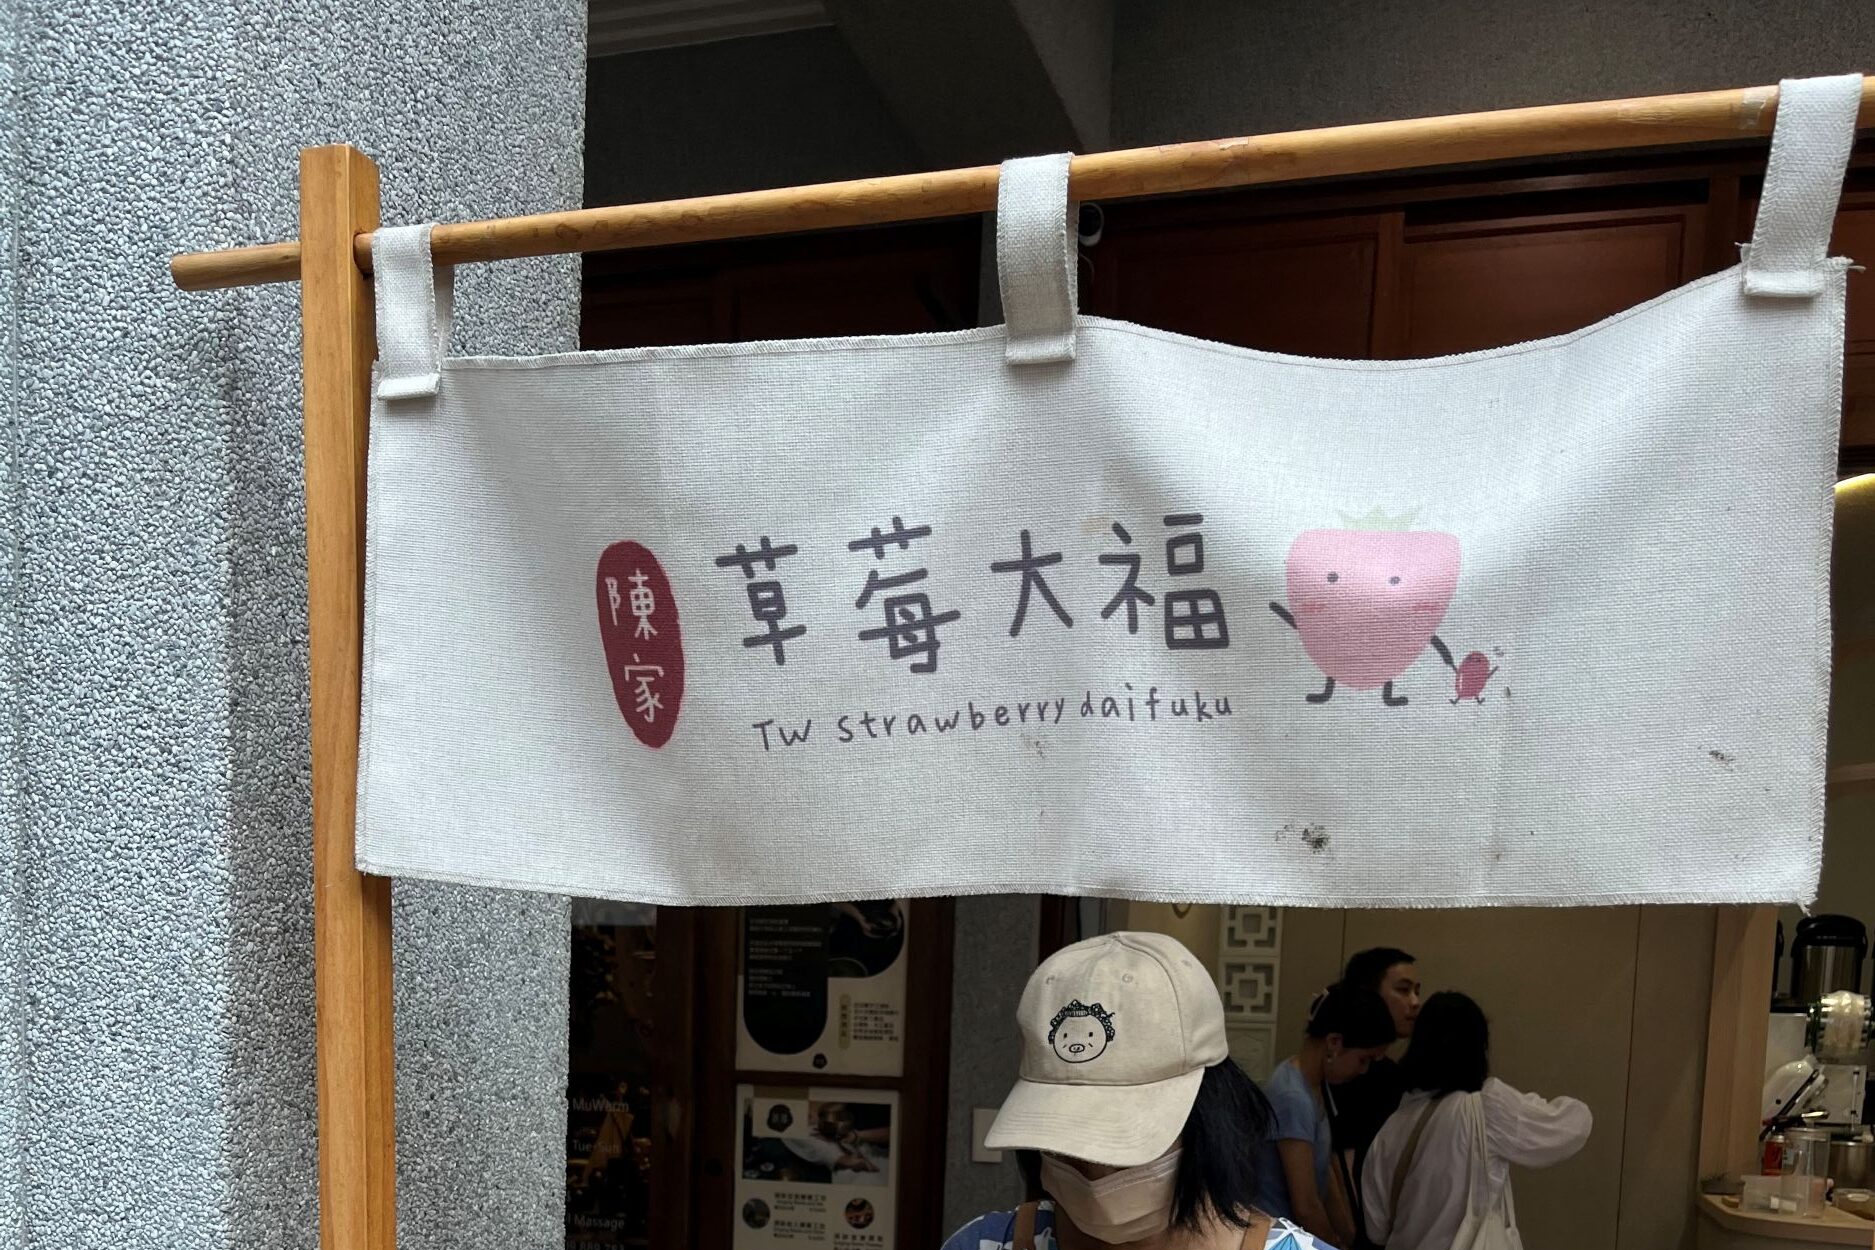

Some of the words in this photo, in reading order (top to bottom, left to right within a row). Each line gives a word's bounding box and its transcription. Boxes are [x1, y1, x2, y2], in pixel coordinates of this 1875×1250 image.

[605, 567, 666, 725] 陳家
[714, 513, 1231, 675] 草莓大福
[752, 717, 811, 752] TW
[837, 690, 1067, 744] strawberry
[1080, 684, 1235, 725] daifuku
